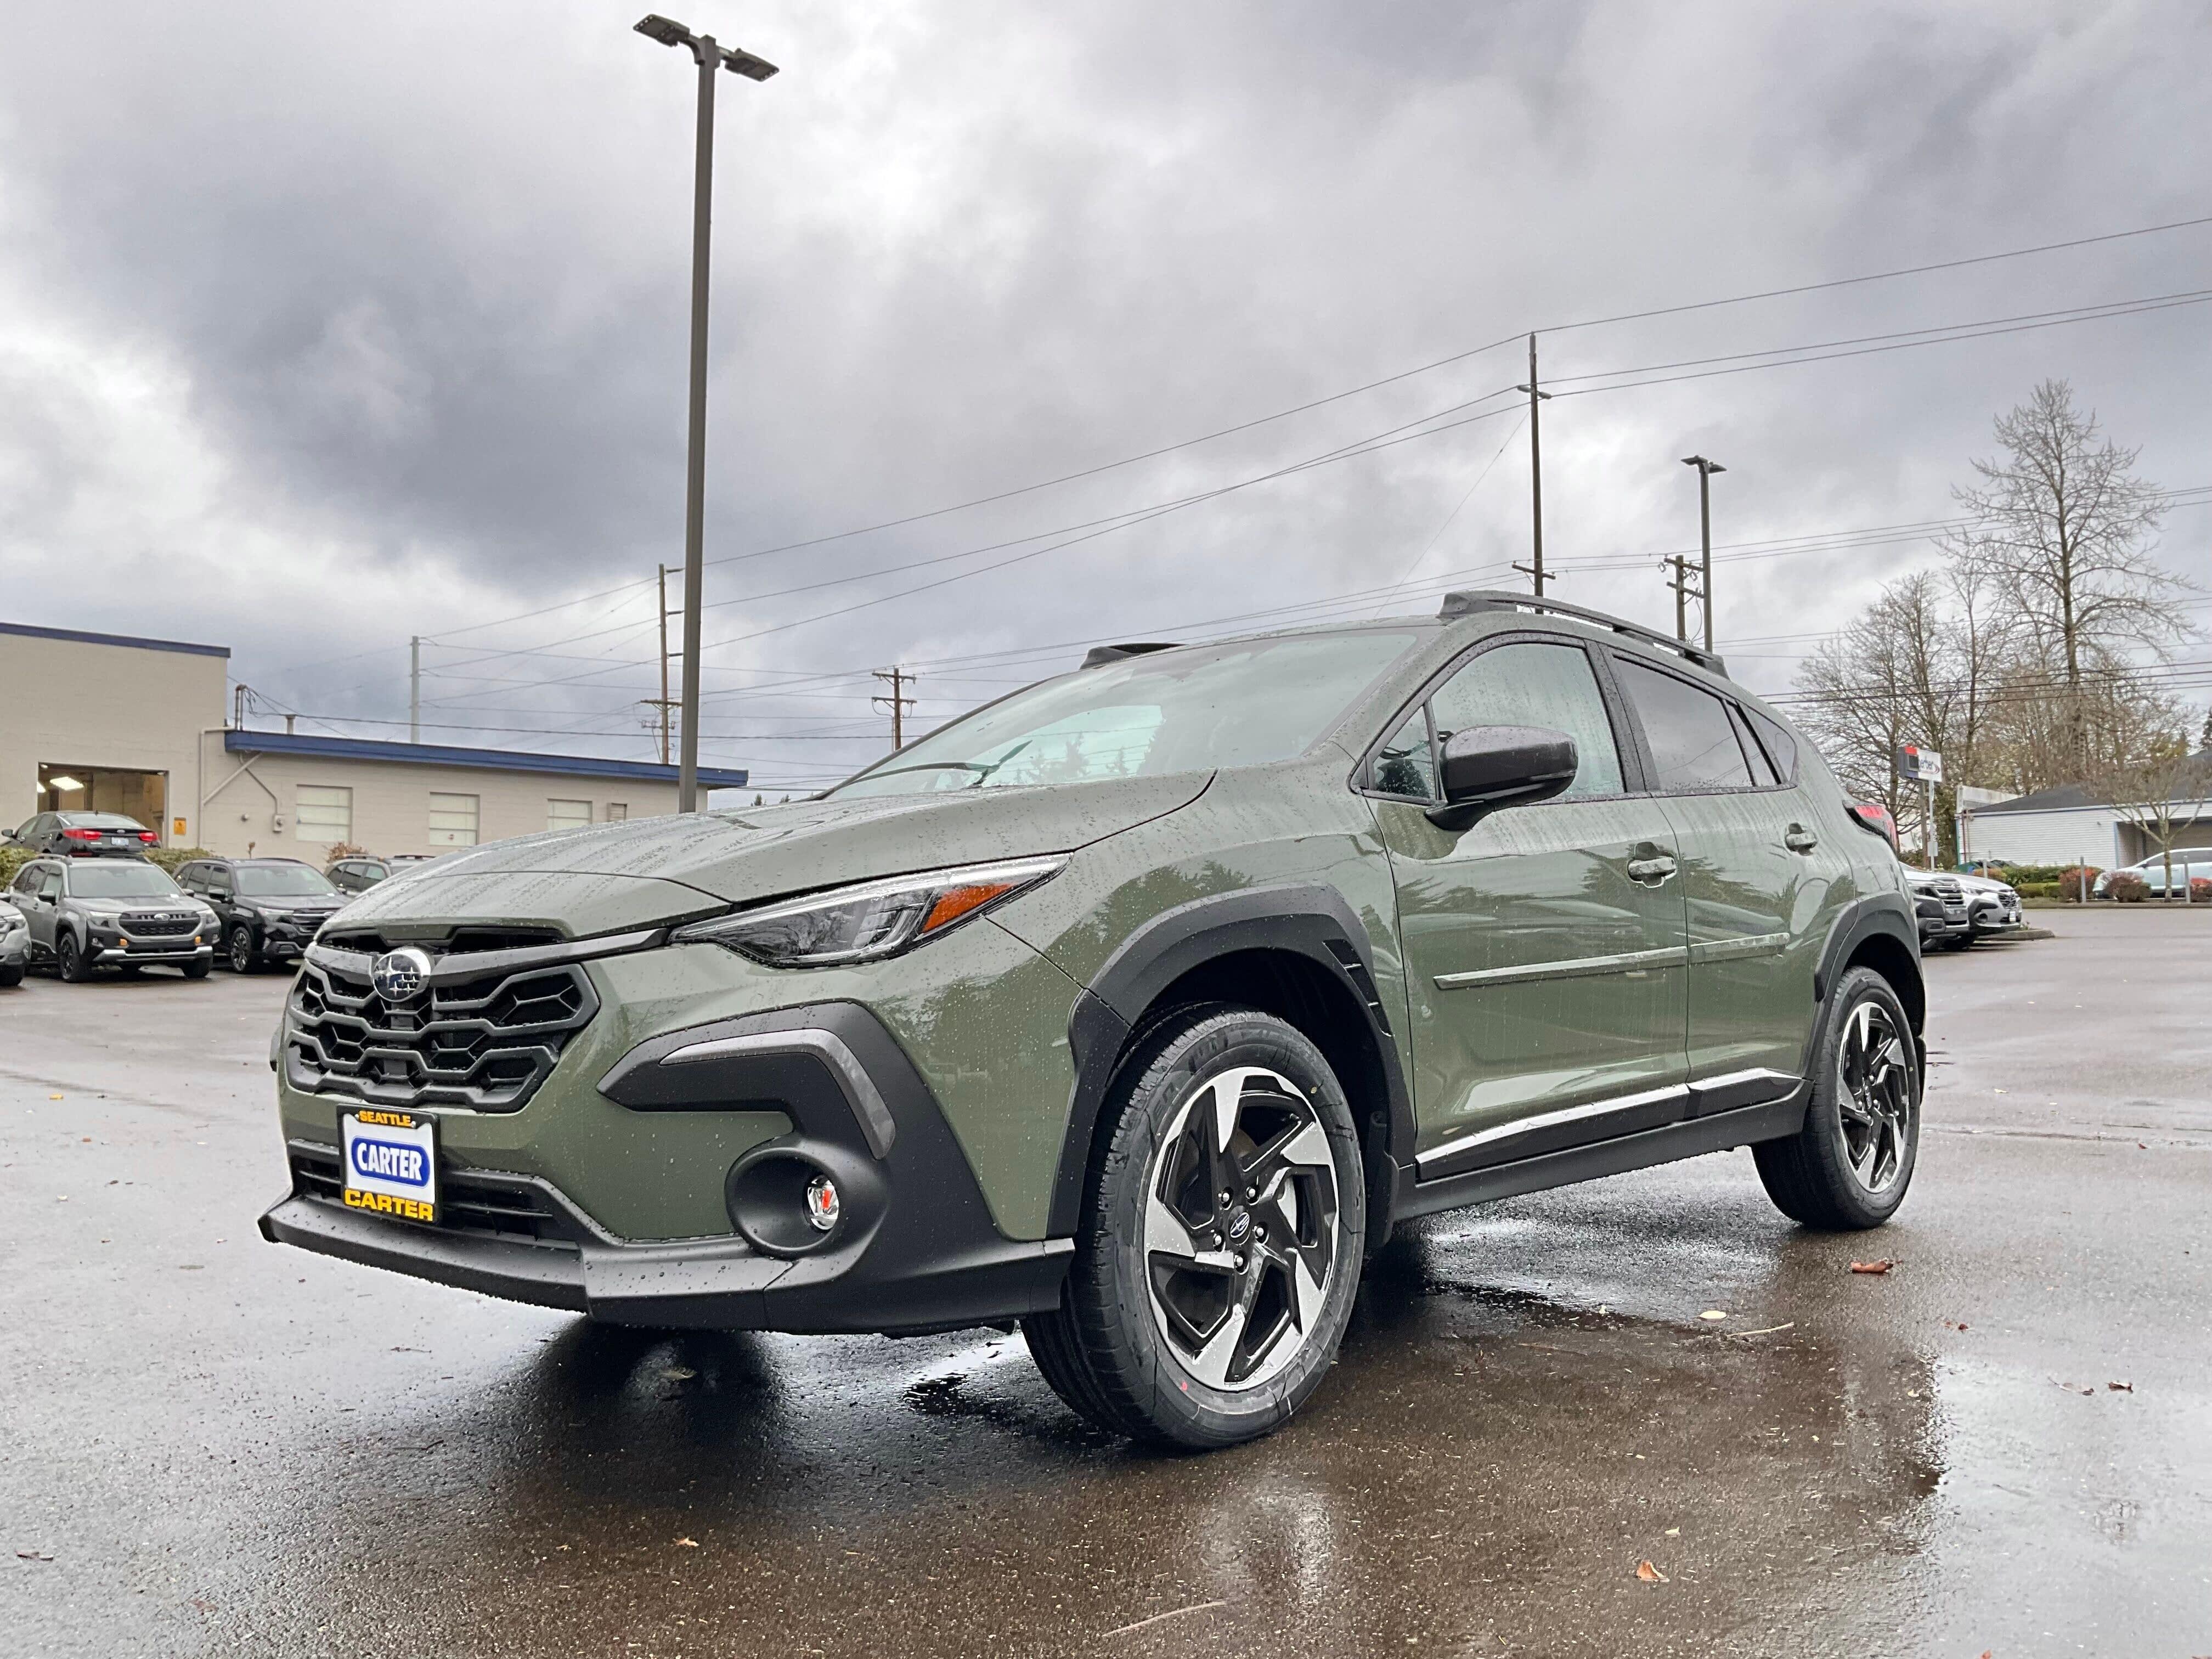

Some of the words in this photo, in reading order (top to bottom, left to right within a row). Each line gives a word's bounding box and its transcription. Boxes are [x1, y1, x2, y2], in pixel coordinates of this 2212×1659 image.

[359, 1110, 413, 1127] SEATTLE
[357, 1142, 422, 1181] CARTER
[345, 1188, 433, 1222] CARTER
